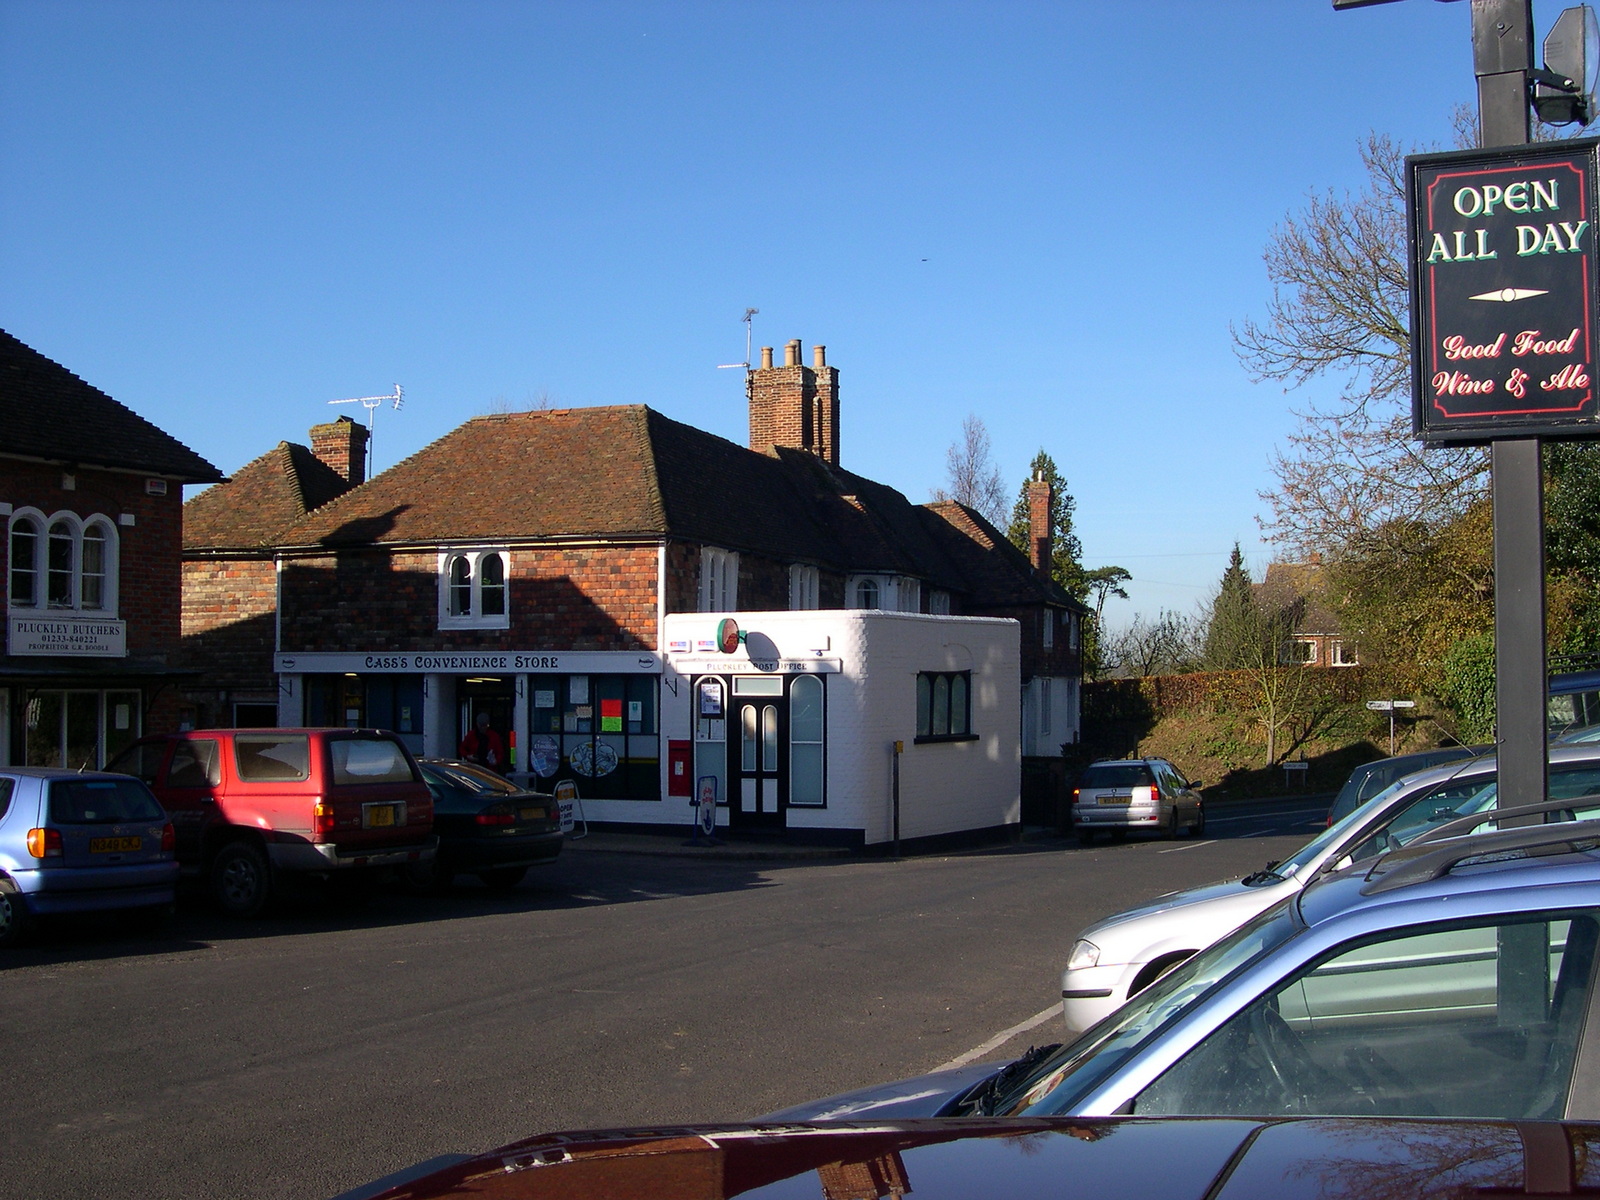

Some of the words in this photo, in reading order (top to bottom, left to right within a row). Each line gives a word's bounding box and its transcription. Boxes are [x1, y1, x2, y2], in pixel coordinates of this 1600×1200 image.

[1453, 178, 1560, 218] OPEN
[1426, 229, 1498, 264] ALL
[1515, 220, 1590, 257] DAY
[1442, 332, 1507, 361] Good
[1511, 328, 1581, 356] Food
[1431, 369, 1494, 398] Wine
[1504, 367, 1530, 399] &
[1539, 363, 1590, 391] Ale
[17, 623, 69, 634] PLUCKLEY
[73, 625, 120, 636] BUTCHERS
[41, 635, 98, 643] 01233-840221
[365, 656, 408, 669] CASS'S
[414, 656, 507, 669] CONVENIENCE
[514, 656, 559, 668] STORE
[707, 663, 748, 671] PLUCKLEY
[753, 663, 773, 671] POST
[777, 663, 807, 671] OFFICE
